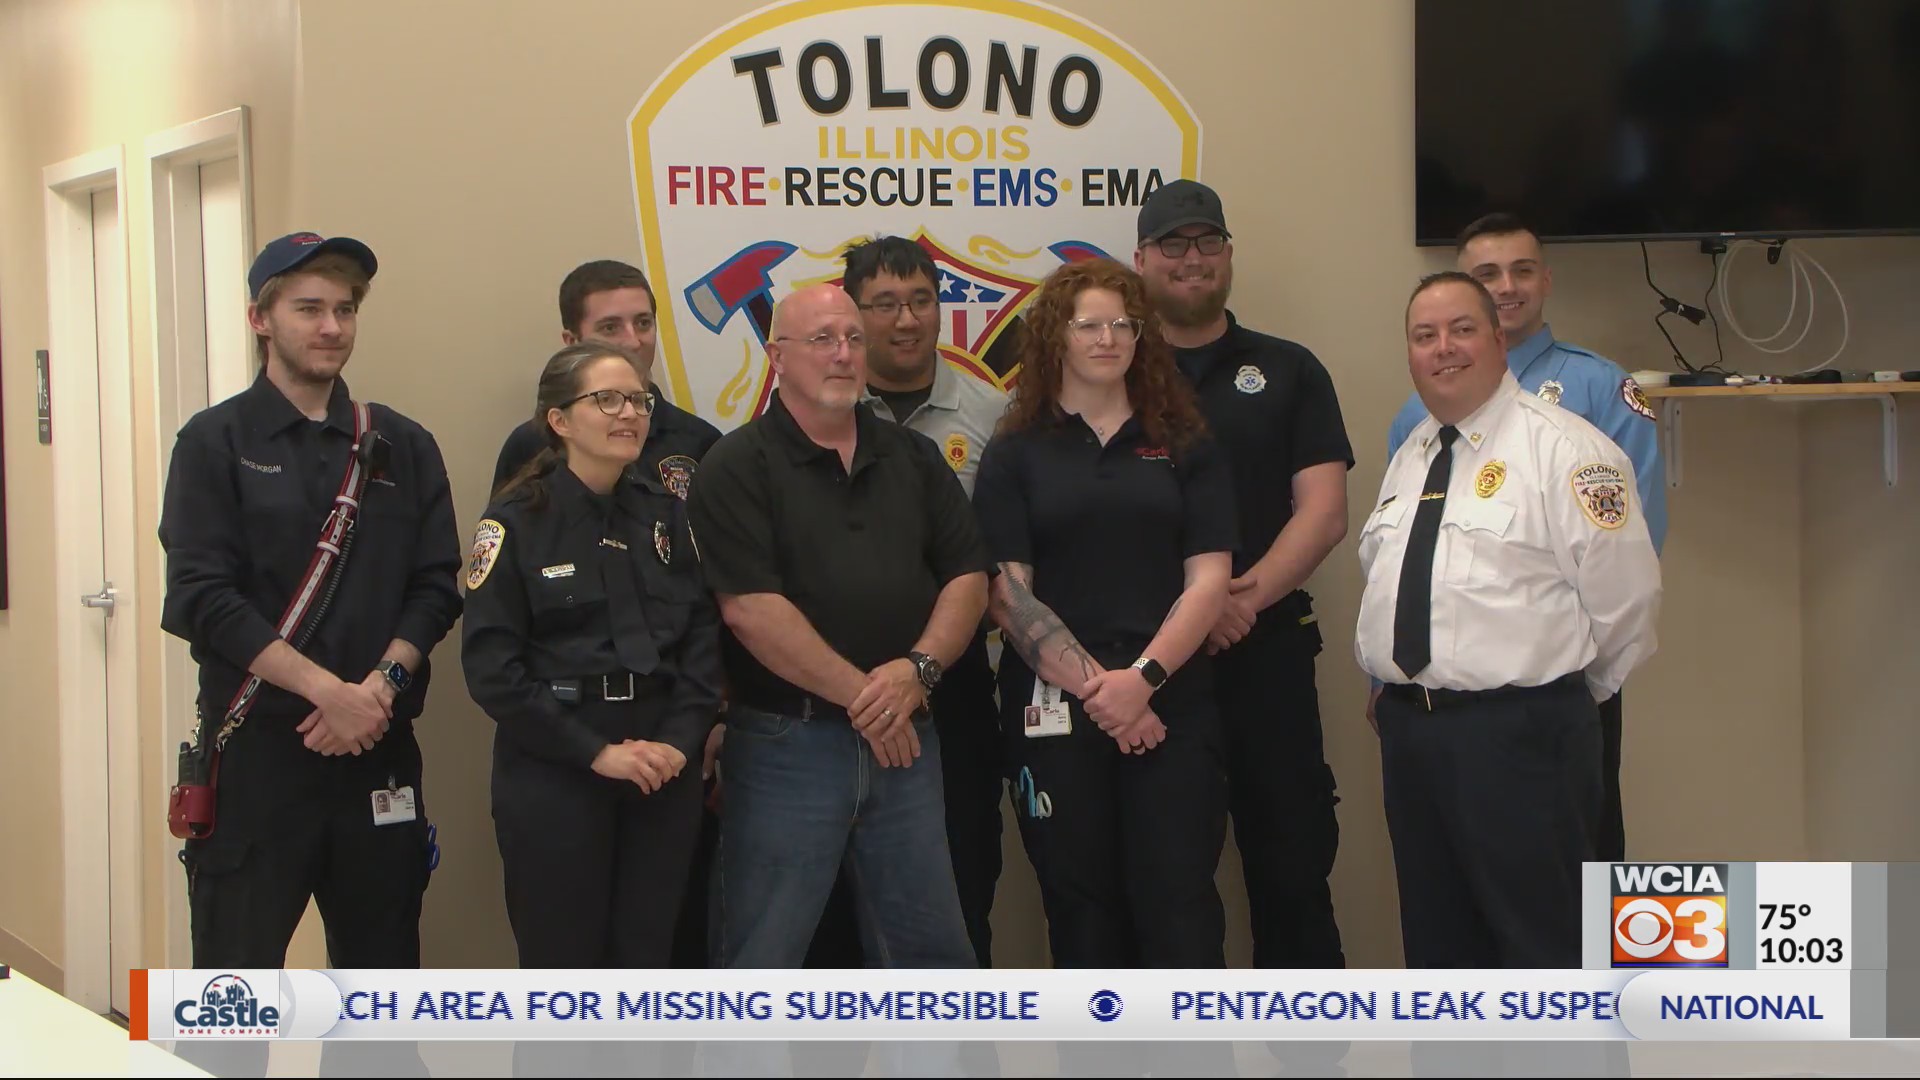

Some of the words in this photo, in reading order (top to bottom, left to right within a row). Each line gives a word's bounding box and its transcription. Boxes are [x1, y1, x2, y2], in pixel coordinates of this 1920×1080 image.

[731, 35, 1102, 128] TOLONO
[818, 125, 1031, 162] ILLINOIS
[667, 165, 766, 206] FIRE
[784, 166, 953, 207] RESCUE
[972, 167, 1059, 208] EMS
[1081, 168, 1165, 207] EMA
[256, 463, 282, 474] MORGAN
[1576, 465, 1619, 480] TOLONO
